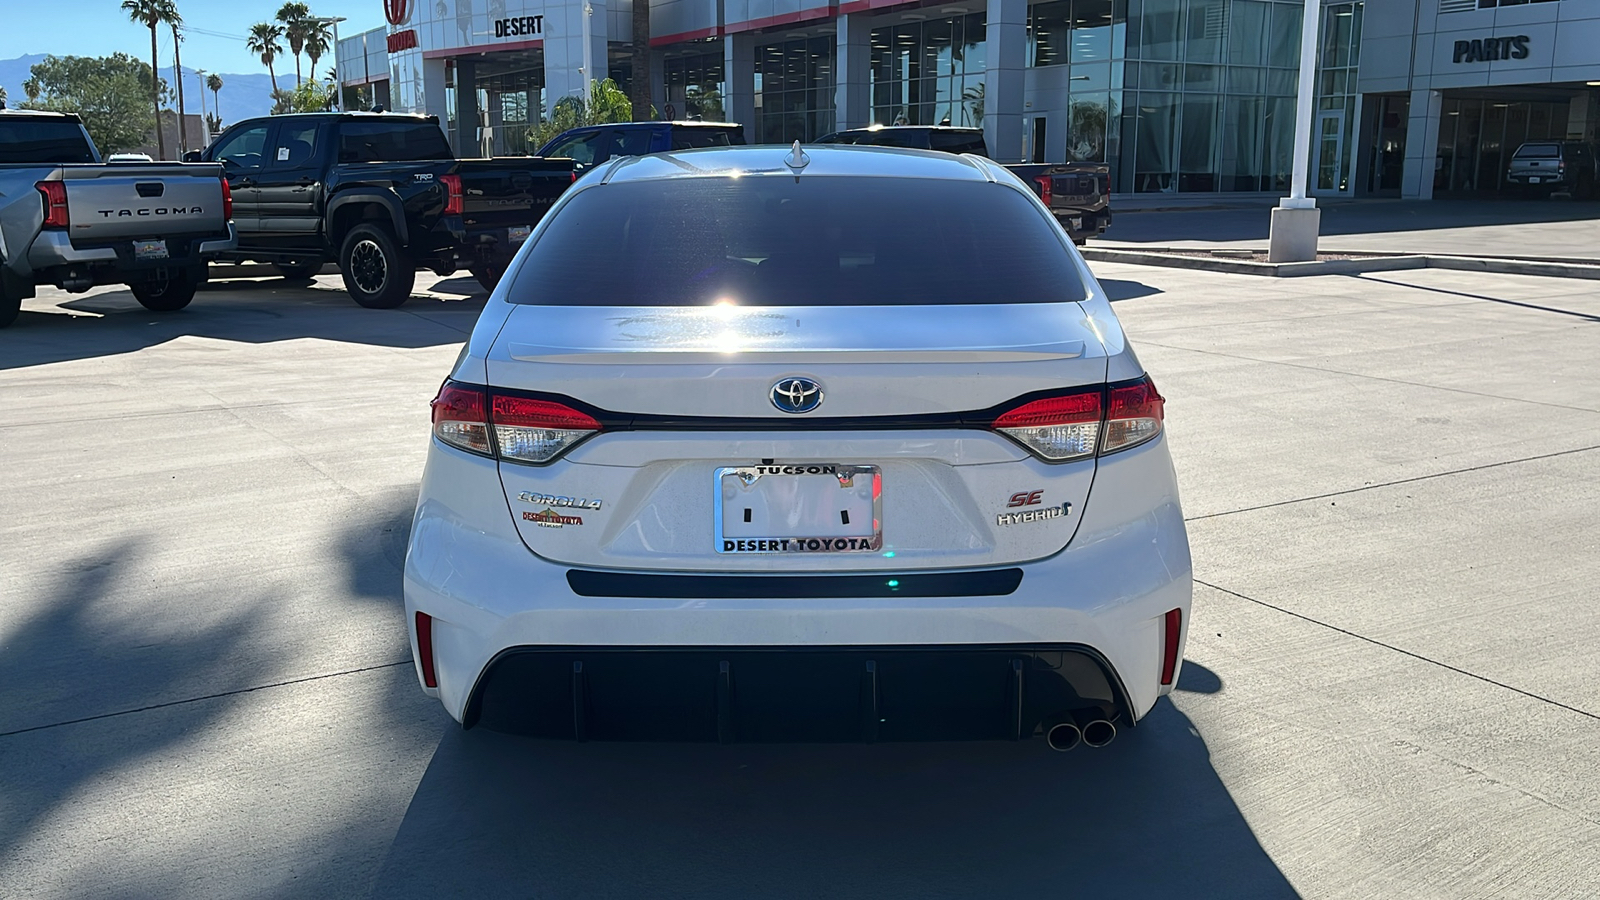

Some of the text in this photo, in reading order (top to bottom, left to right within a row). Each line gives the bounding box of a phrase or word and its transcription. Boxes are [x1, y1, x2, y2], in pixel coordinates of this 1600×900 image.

[495, 15, 544, 38] DESERT
[386, 29, 418, 53] TOYOTA
[1453, 35, 1530, 63] PARTS
[413, 173, 434, 181] TRD
[98, 206, 204, 217] TACOMA
[757, 466, 837, 475] TUCSON
[517, 490, 602, 511] COROLLA
[1006, 489, 1044, 508] SE
[997, 506, 1061, 526] HYBRID
[723, 538, 872, 552] DESERT TOYOTA
